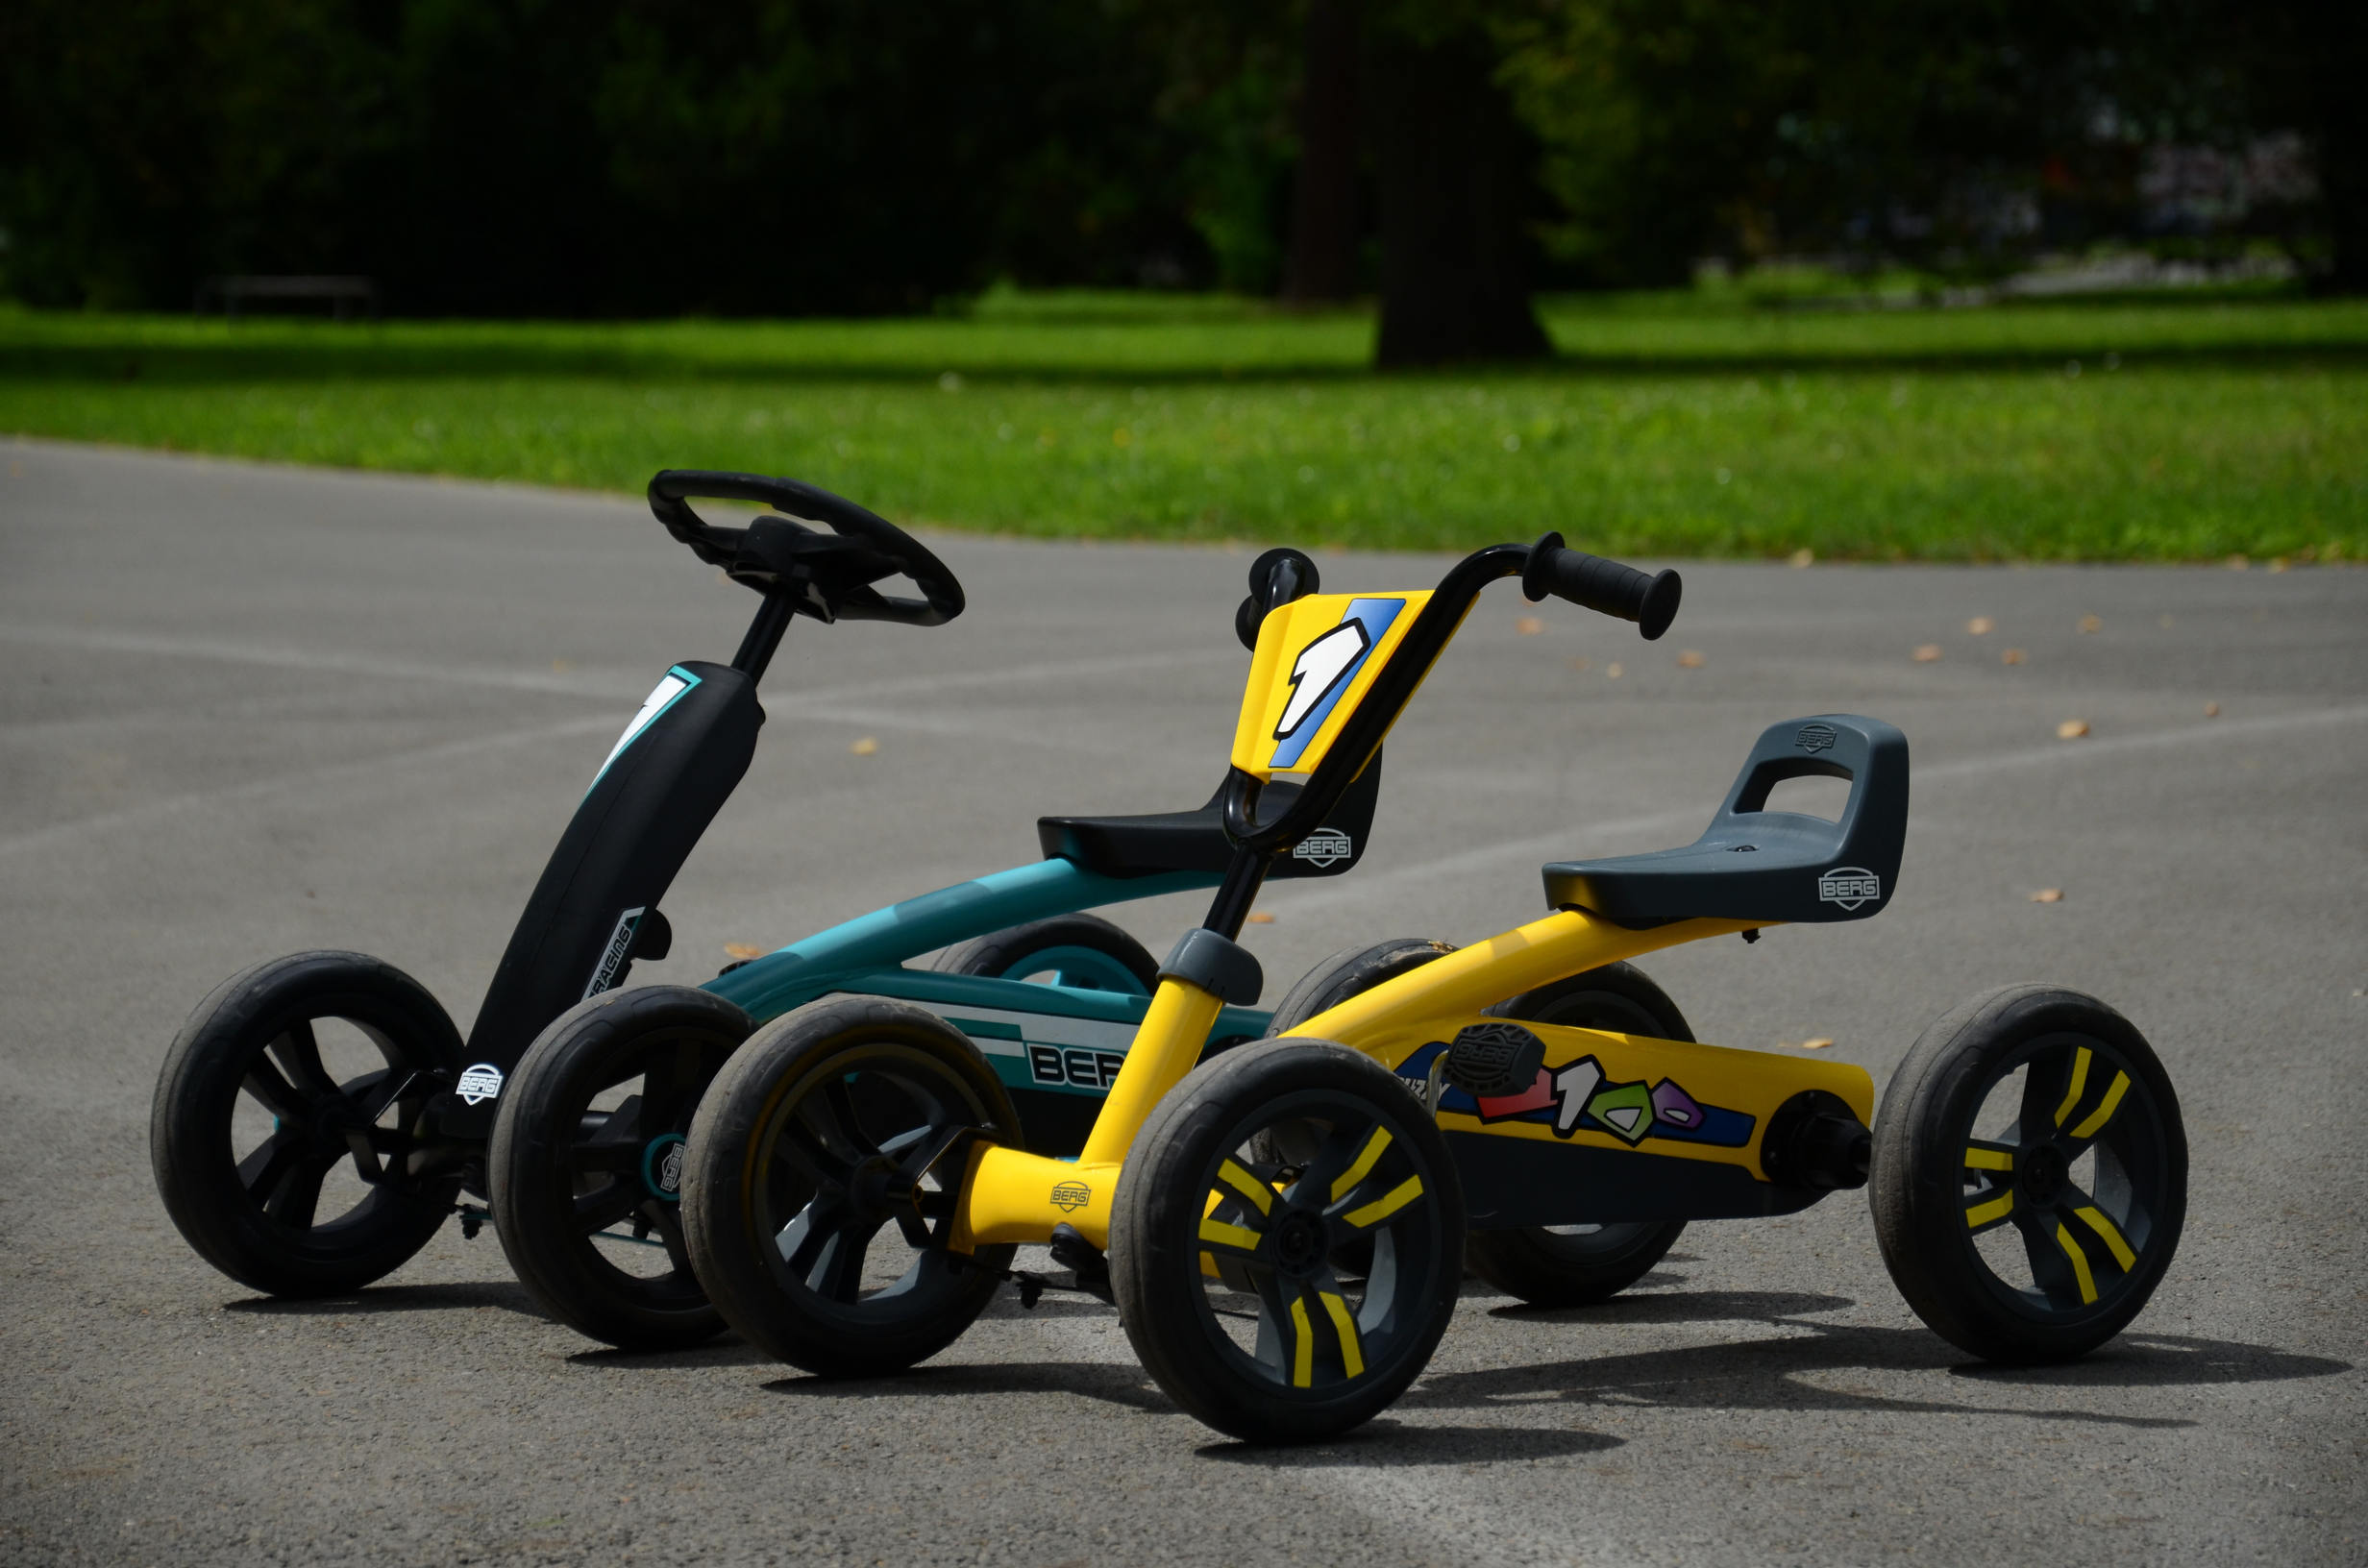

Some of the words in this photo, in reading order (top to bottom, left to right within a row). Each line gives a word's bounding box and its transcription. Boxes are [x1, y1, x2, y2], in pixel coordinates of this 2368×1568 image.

[1273, 617, 1371, 741] 1
[1295, 839, 1347, 854] BERG
[1822, 879, 1877, 896] BERG
[593, 925, 631, 994] RACING
[1027, 1043, 1125, 1090] BER
[458, 1075, 500, 1094] BERG
[663, 1146, 683, 1190] BERG
[1052, 1189, 1088, 1203] BERG
